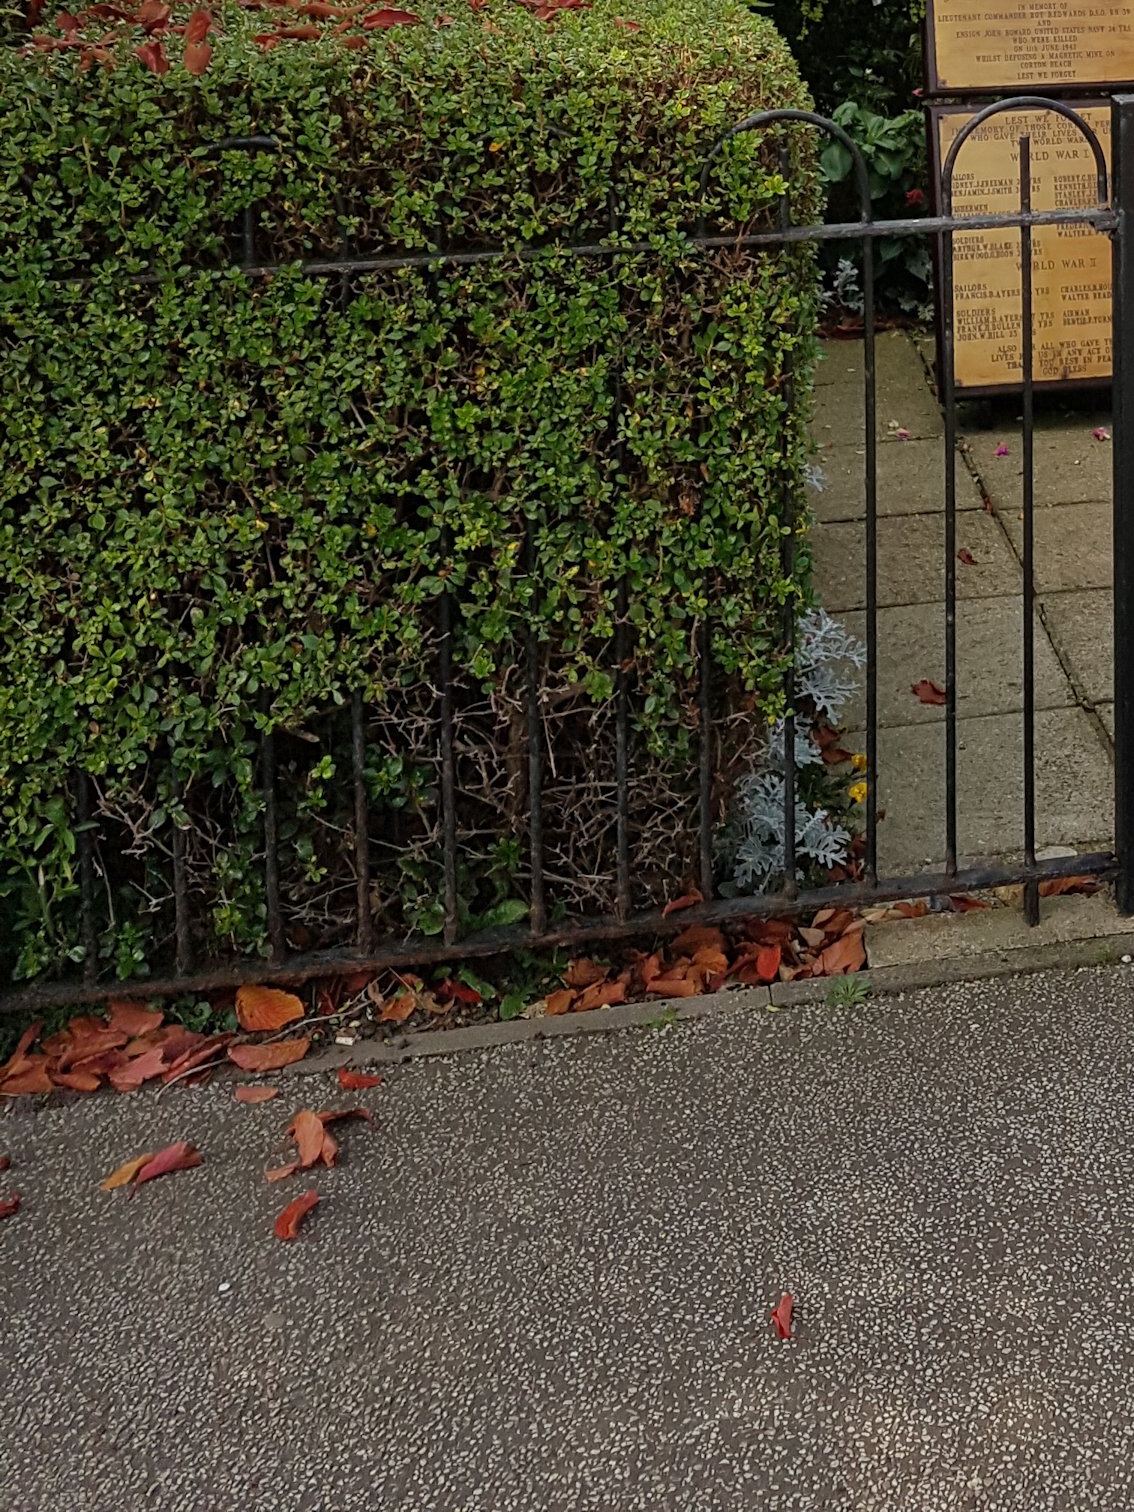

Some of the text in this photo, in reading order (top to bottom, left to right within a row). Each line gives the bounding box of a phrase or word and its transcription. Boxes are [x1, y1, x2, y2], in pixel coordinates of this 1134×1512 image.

[1029, 2, 1056, 11] MEMORY
[938, 13, 981, 22] LIEUTENANT
[984, 12, 1026, 20] COMMANDER
[1037, 19, 1051, 27] AND
[956, 30, 981, 39] ENSIGN
[1034, 26, 1059, 35] UNITED
[1062, 26, 1085, 34] STATES
[1088, 25, 1105, 33] NAVY
[1118, 24, 1131, 32] YRS
[1013, 34, 1078, 44] WHO WERE KILLED
[1041, 44, 1059, 52] JUNE
[976, 54, 1001, 63] WHILST
[1004, 53, 1037, 62] DEFUSING
[1048, 51, 1083, 60] MAGNETIC
[1086, 50, 1103, 58] MINE
[1020, 60, 1072, 69] CORTON BEACH
[1017, 70, 1076, 80] LEST WE FORGET
[1005, 116, 1028, 125] LEST
[1035, 114, 1049, 123] WE
[971, 125, 1004, 135] EMORY
[1009, 124, 1020, 132] OF
[1024, 122, 1052, 131] THOSE
[970, 134, 989, 142] WHO
[994, 132, 1016, 141] GAVE
[1052, 129, 1077, 137] LIVES
[1033, 137, 1063, 145] WORLD
[1010, 151, 1050, 162] WRLD
[1056, 150, 1080, 160] WAR
[951, 173, 975, 181] AILORS
[1016, 260, 1055, 272] WRLD
[1062, 258, 1085, 268] WAR
[954, 283, 987, 292] SAILORS
[1035, 287, 1050, 296] YRS
[1061, 292, 1089, 301] WALTER
[956, 308, 996, 318] SOLDIERS
[1040, 311, 1055, 320] YRS
[1063, 308, 1090, 318] AIRMAN
[1038, 320, 1053, 328] YRS
[997, 345, 1017, 353] ALSO
[1040, 342, 1055, 350] ALL
[1059, 340, 1077, 349] WHO
[1080, 339, 1100, 347] GAVE
[991, 353, 1014, 363] LIVES
[1067, 348, 1083, 356] ANY
[1086, 347, 1101, 355] ACT
[1039, 359, 1054, 367] YOU
[1083, 356, 1092, 364] IN
[1042, 367, 1059, 376] GOD
